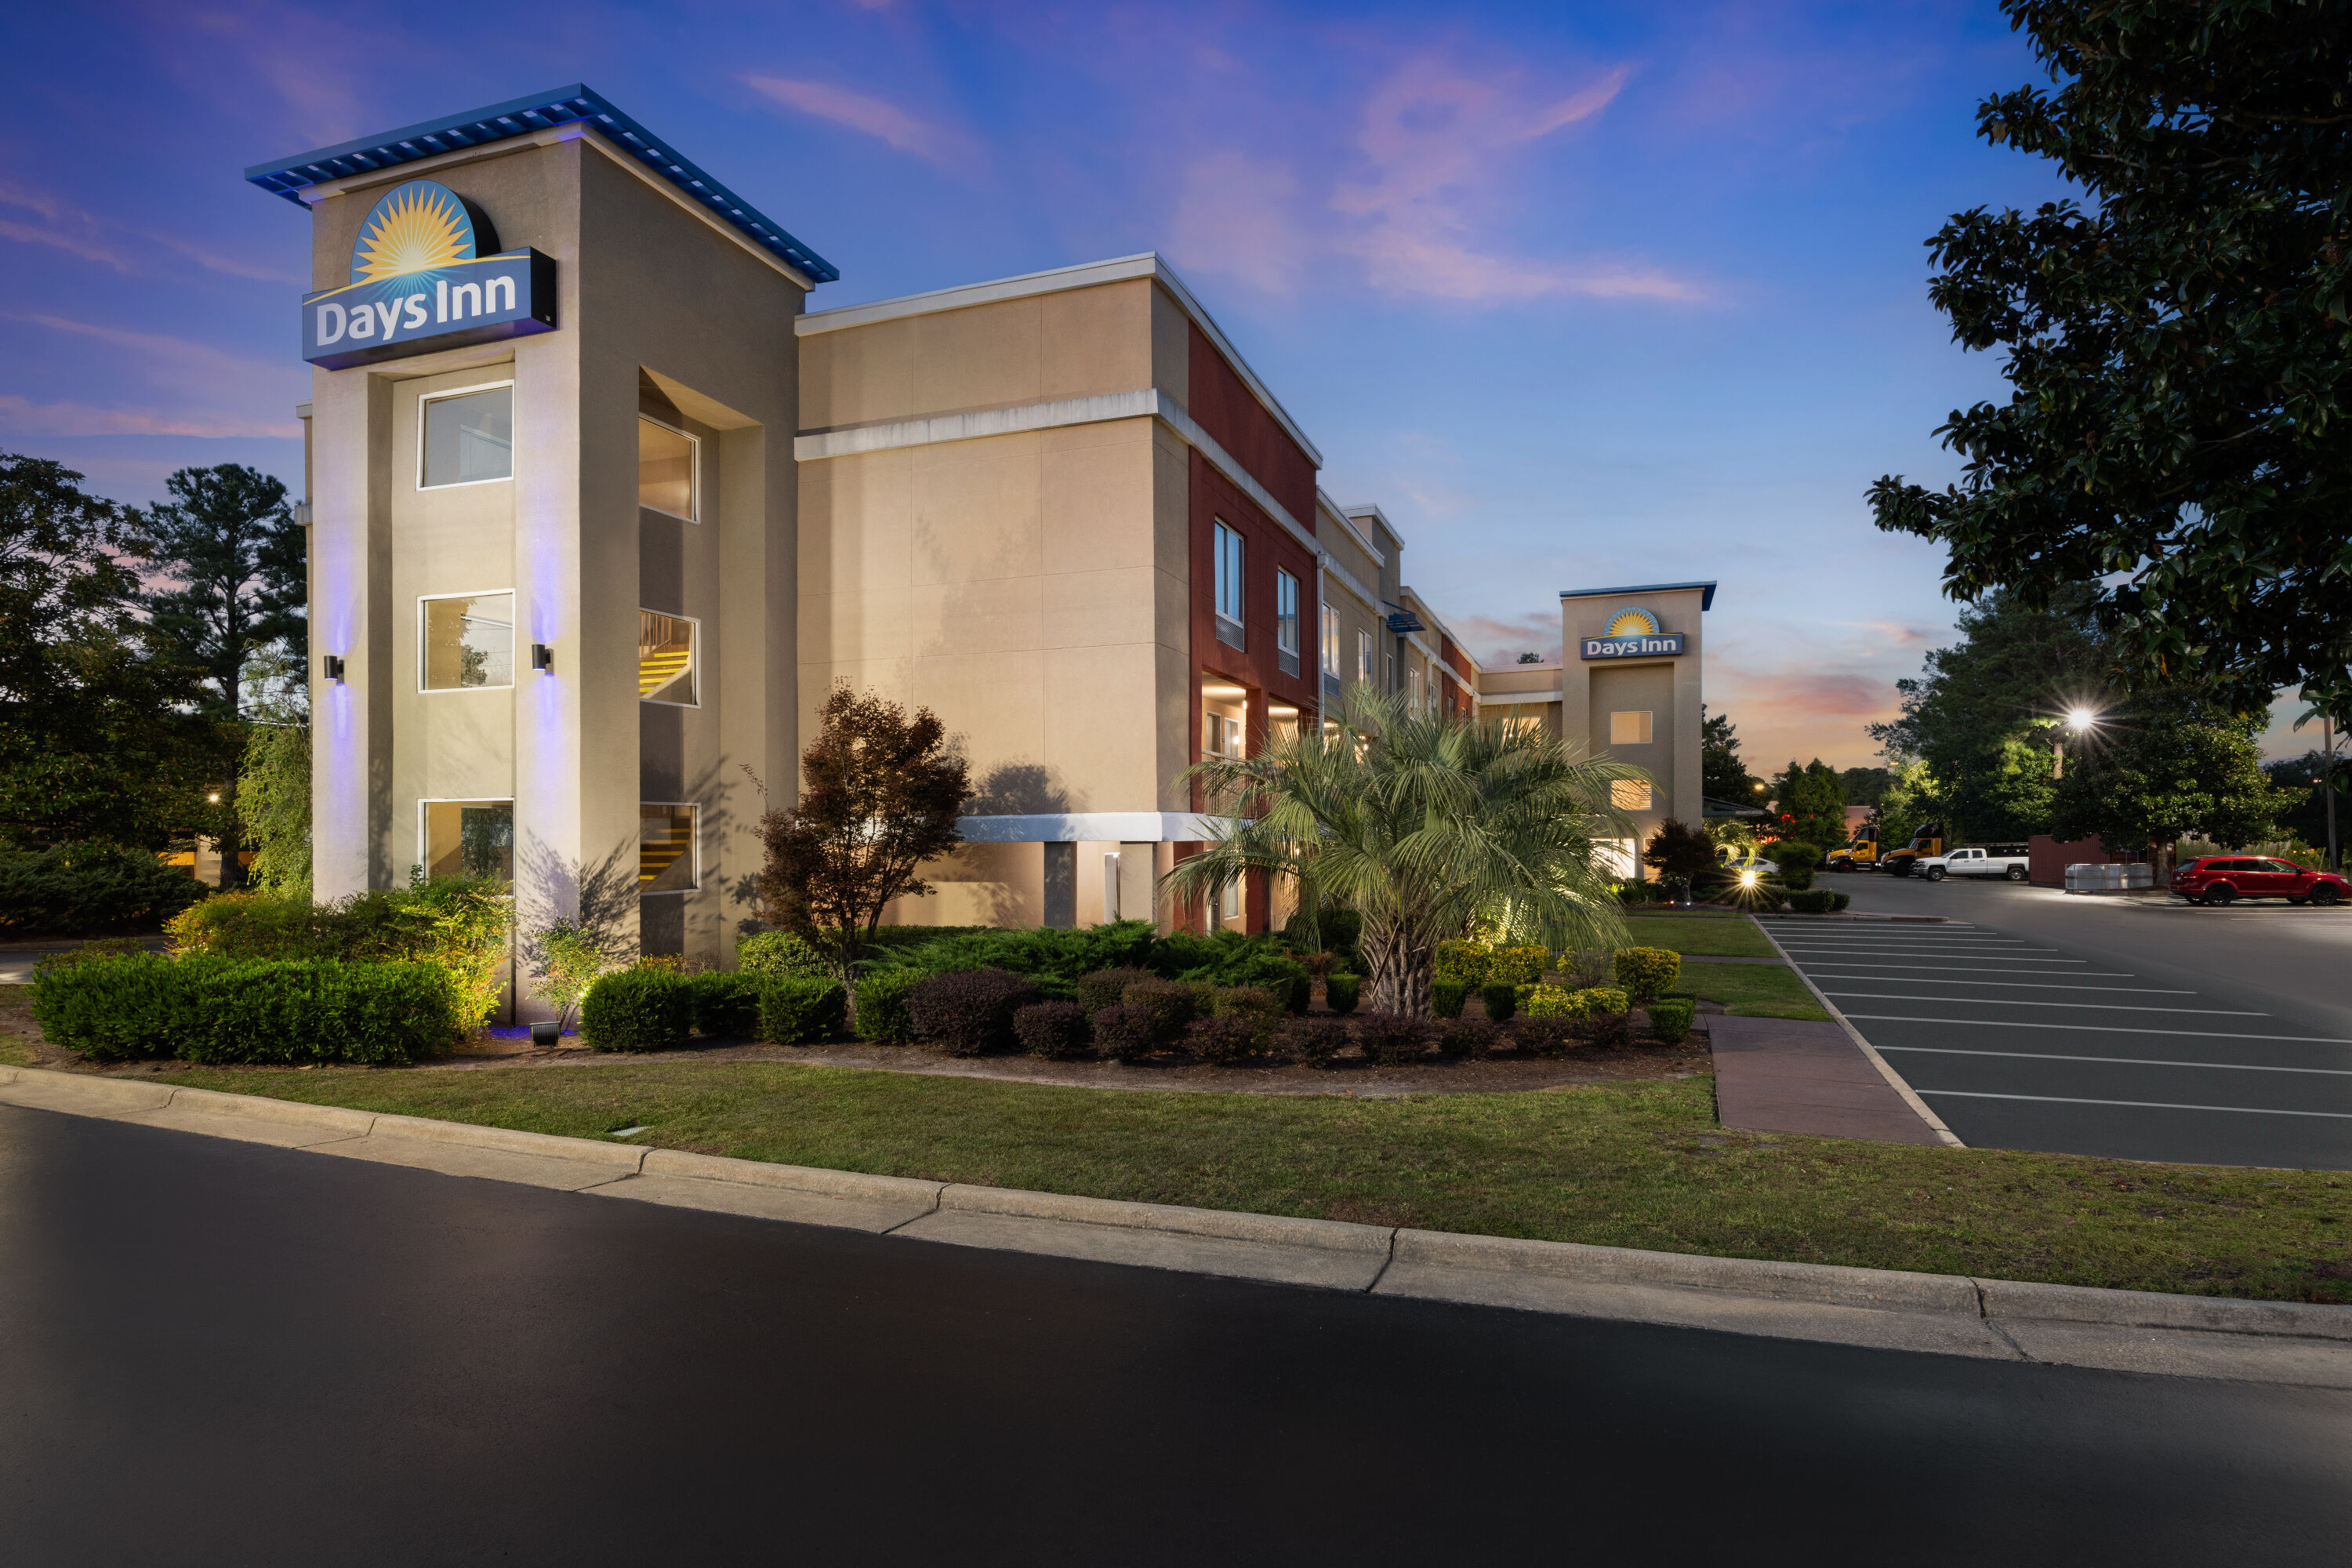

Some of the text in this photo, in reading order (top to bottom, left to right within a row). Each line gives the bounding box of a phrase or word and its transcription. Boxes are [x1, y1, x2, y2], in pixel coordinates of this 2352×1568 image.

[317, 275, 516, 347] Days Inn
[1587, 638, 1676, 656] Days Inn
